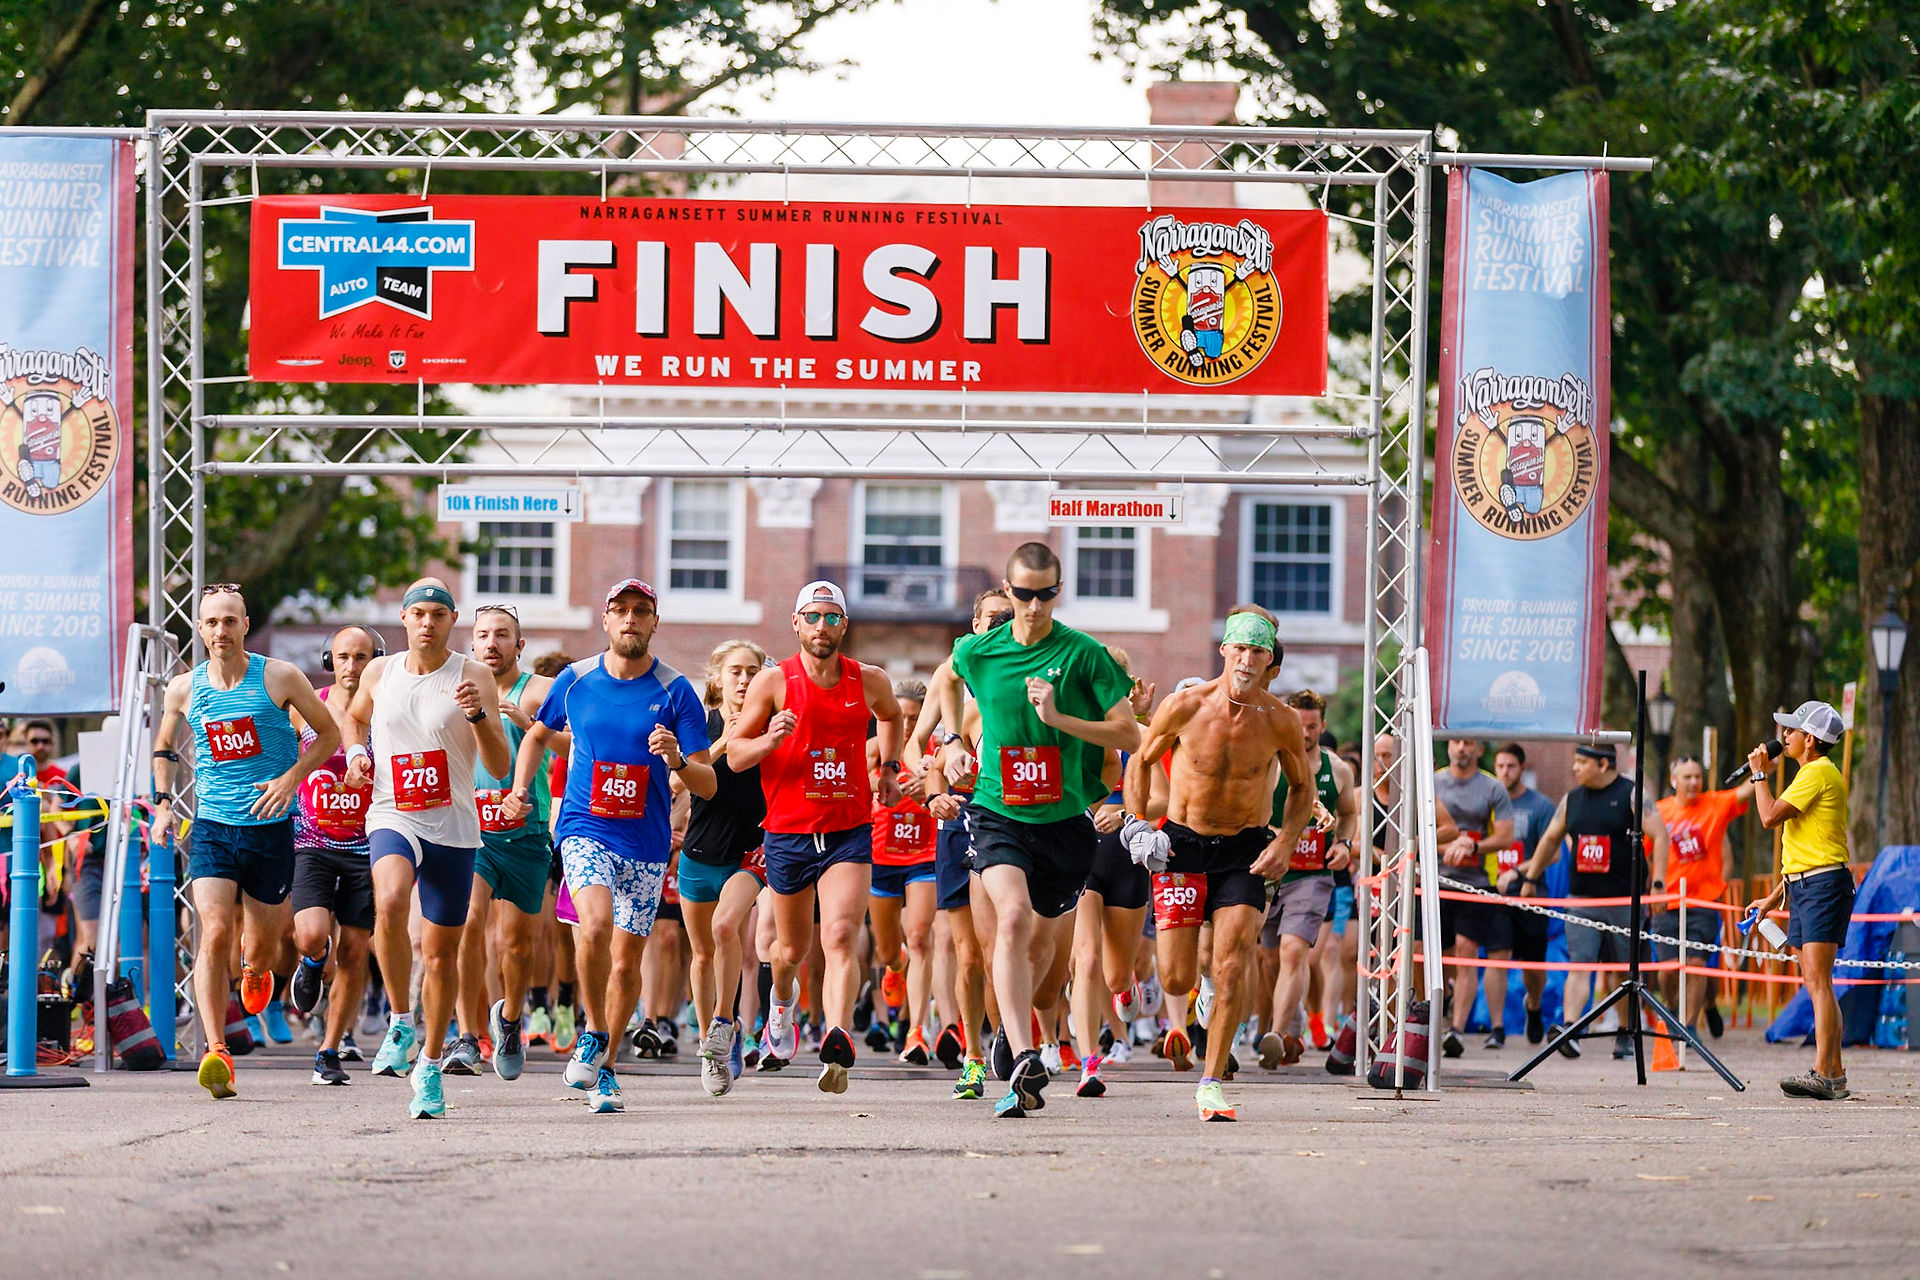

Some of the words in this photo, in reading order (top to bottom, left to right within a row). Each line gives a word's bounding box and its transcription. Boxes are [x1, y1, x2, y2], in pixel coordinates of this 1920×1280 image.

[0, 162, 104, 180] ARRAGANSETT
[579, 206, 726, 221] NARRAGANSETT
[737, 208, 812, 222] SUMMER
[823, 210, 905, 224] RUNNING
[916, 211, 1003, 225] FESTIVAL
[1477, 193, 1582, 220] NARRAGANSETT
[1477, 209, 1580, 244] SUMMER
[0, 237, 101, 267] ESTIVAL
[287, 235, 466, 254] CENTRAL44.COM
[1136, 214, 1273, 275] Narragansett
[1475, 234, 1585, 268] RUNNING
[329, 277, 368, 297] AUTO
[383, 276, 423, 299] TEAM
[1473, 262, 1584, 295] FESTIVAL
[536, 239, 1053, 345] FINISH
[1138, 276, 1166, 353] SUMMER
[1241, 283, 1274, 361] FESTIVAL
[351, 323, 384, 339] Make
[389, 323, 401, 339] It
[405, 323, 425, 339] Fun
[337, 353, 373, 367] Jeep
[595, 354, 643, 376] WE
[661, 355, 731, 378] RUN
[750, 357, 817, 380] THE
[835, 358, 982, 382] SUMMER
[1458, 366, 1594, 428] Narragansett
[78, 410, 113, 490] FESTIVAL
[1457, 428, 1485, 507] SUMMER
[1560, 436, 1593, 517] FESTIVAL
[445, 495, 471, 511] 10k
[474, 495, 520, 511] Finish
[523, 496, 558, 511] Here
[1050, 500, 1082, 516] Half
[1086, 500, 1163, 517] Marathon
[0, 574, 40, 589] OUDLY
[42, 575, 101, 590] RUNNING
[0, 591, 20, 611] HE
[23, 591, 102, 611] SUMMER
[1461, 598, 1518, 613] PROUDLY
[1520, 600, 1578, 615] RUNNING
[0, 614, 46, 637] INCE
[51, 615, 101, 638] 2013
[1461, 615, 1495, 635] THE
[1500, 616, 1578, 638] SUMMER
[1459, 638, 1522, 661] SINCE
[1525, 640, 1576, 663] 2013
[212, 730, 255, 752] 1304
[401, 766, 439, 789] 278
[813, 761, 847, 780] 564
[1012, 761, 1047, 782] 301
[601, 777, 637, 798] 458
[320, 793, 361, 810] 1260
[481, 804, 511, 821] 67
[894, 823, 920, 839] 821
[1582, 844, 1604, 859] 470
[1163, 886, 1197, 906] 559
